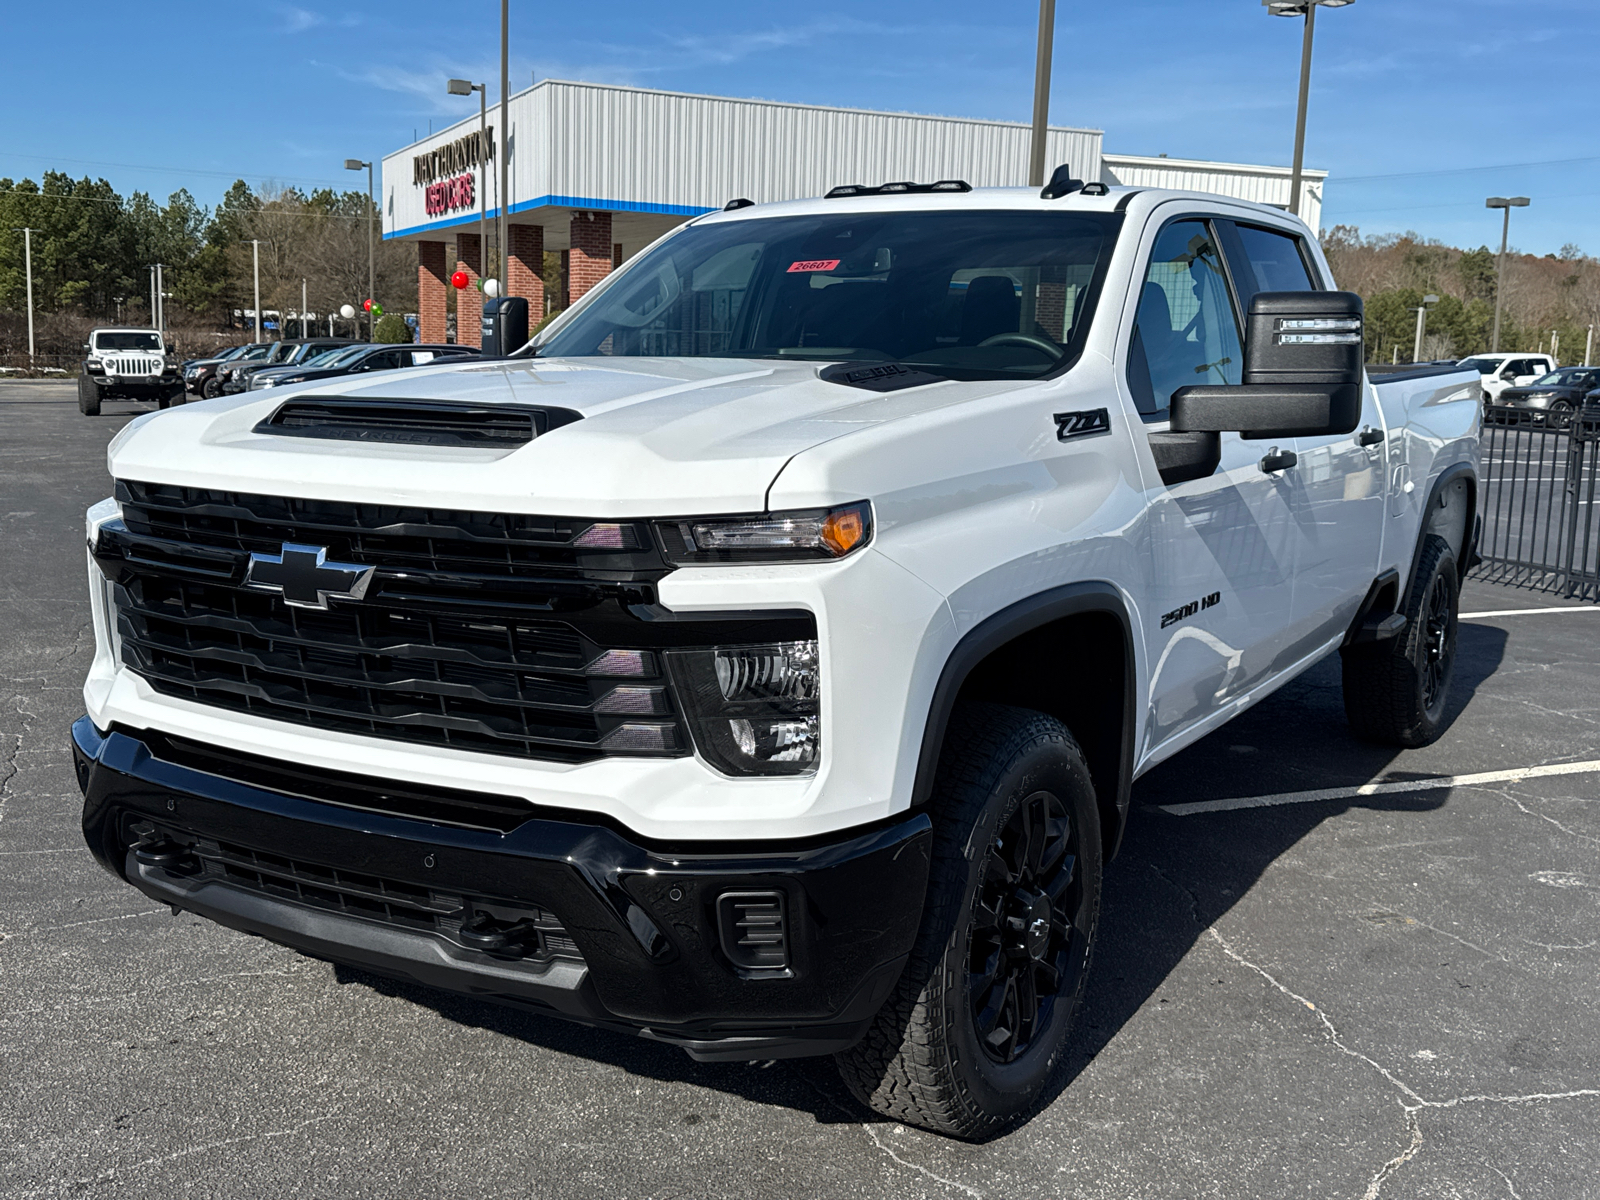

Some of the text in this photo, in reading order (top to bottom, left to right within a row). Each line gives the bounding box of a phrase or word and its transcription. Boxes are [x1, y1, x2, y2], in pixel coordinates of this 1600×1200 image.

[413, 151, 437, 186] JOHN
[425, 172, 473, 215] USED CARS
[793, 261, 833, 271] 26607
[1053, 407, 1110, 441] Z71
[1160, 591, 1221, 630] 2500 HD
